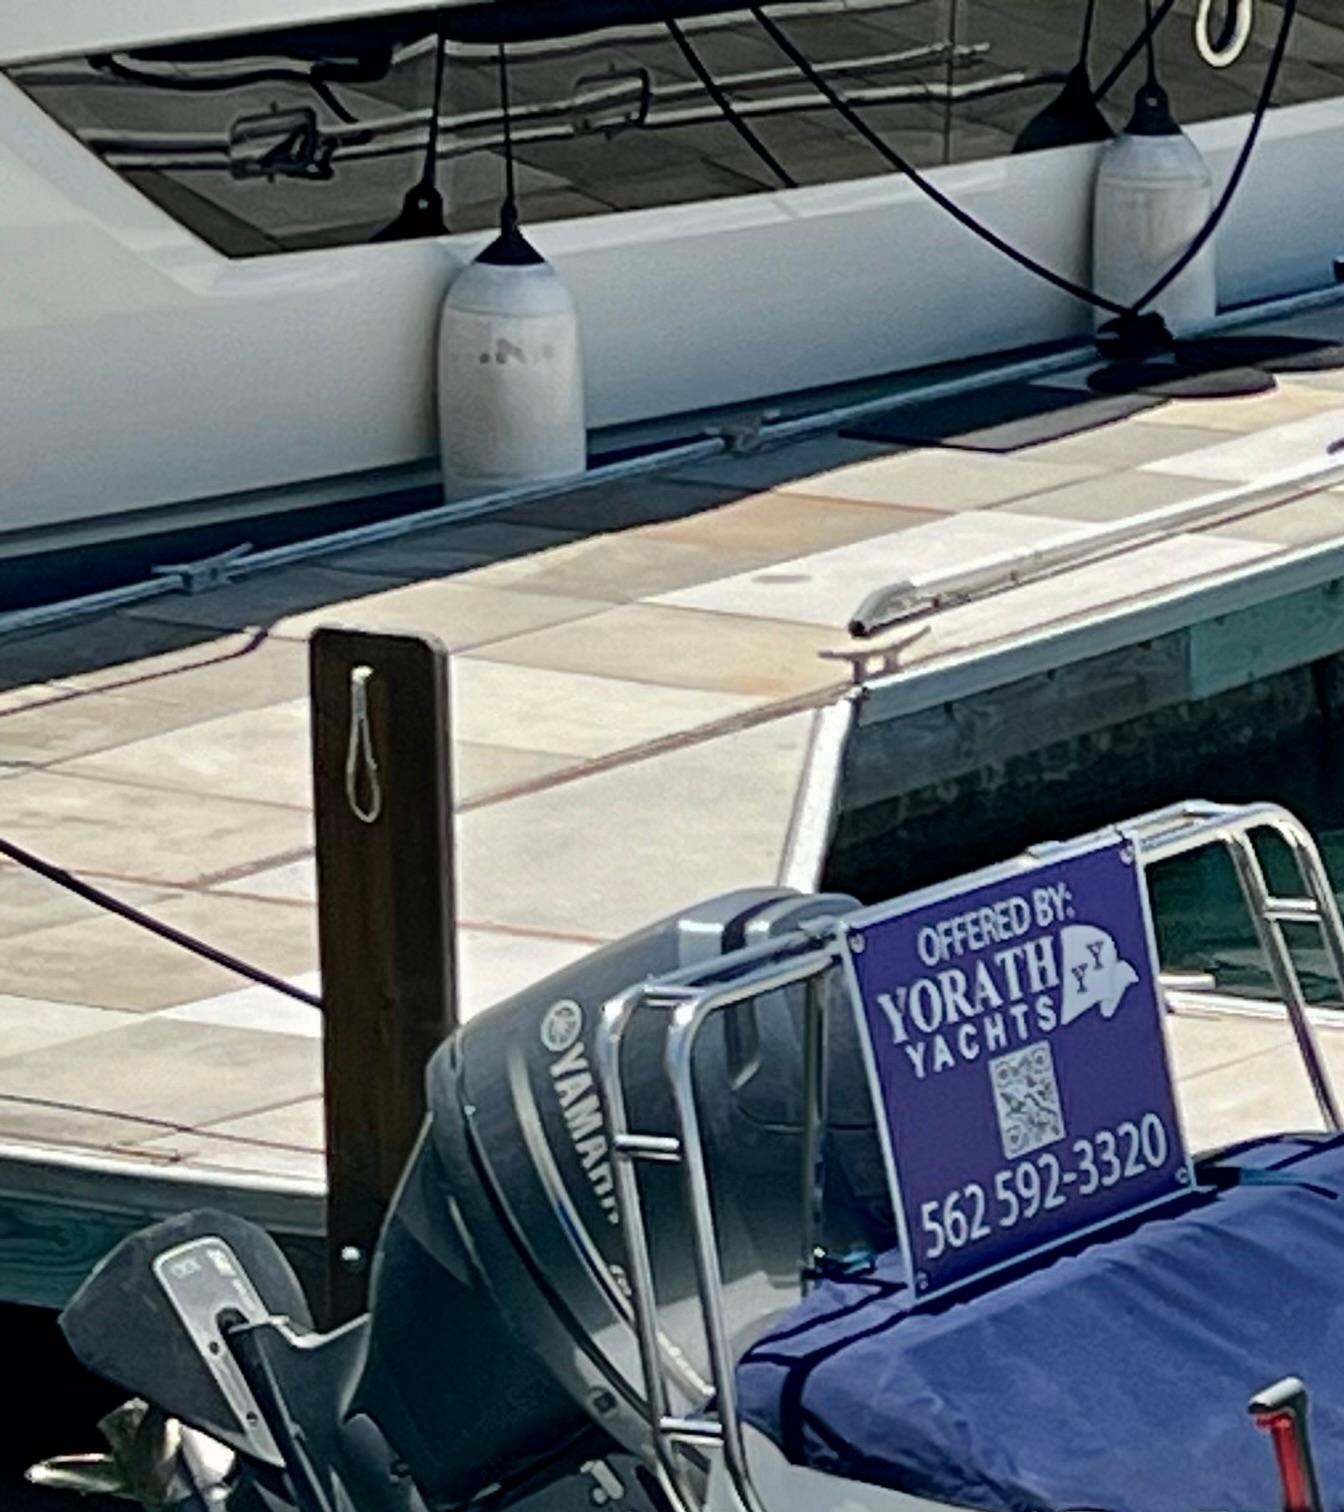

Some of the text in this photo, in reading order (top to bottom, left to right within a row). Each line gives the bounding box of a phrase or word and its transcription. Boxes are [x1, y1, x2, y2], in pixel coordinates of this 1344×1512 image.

[917, 882, 1075, 966] OFFERED BY:
[877, 935, 1060, 1043] YORATH
[905, 997, 1057, 1079] YACHTS
[921, 1112, 1168, 1259] 562 592-3320
